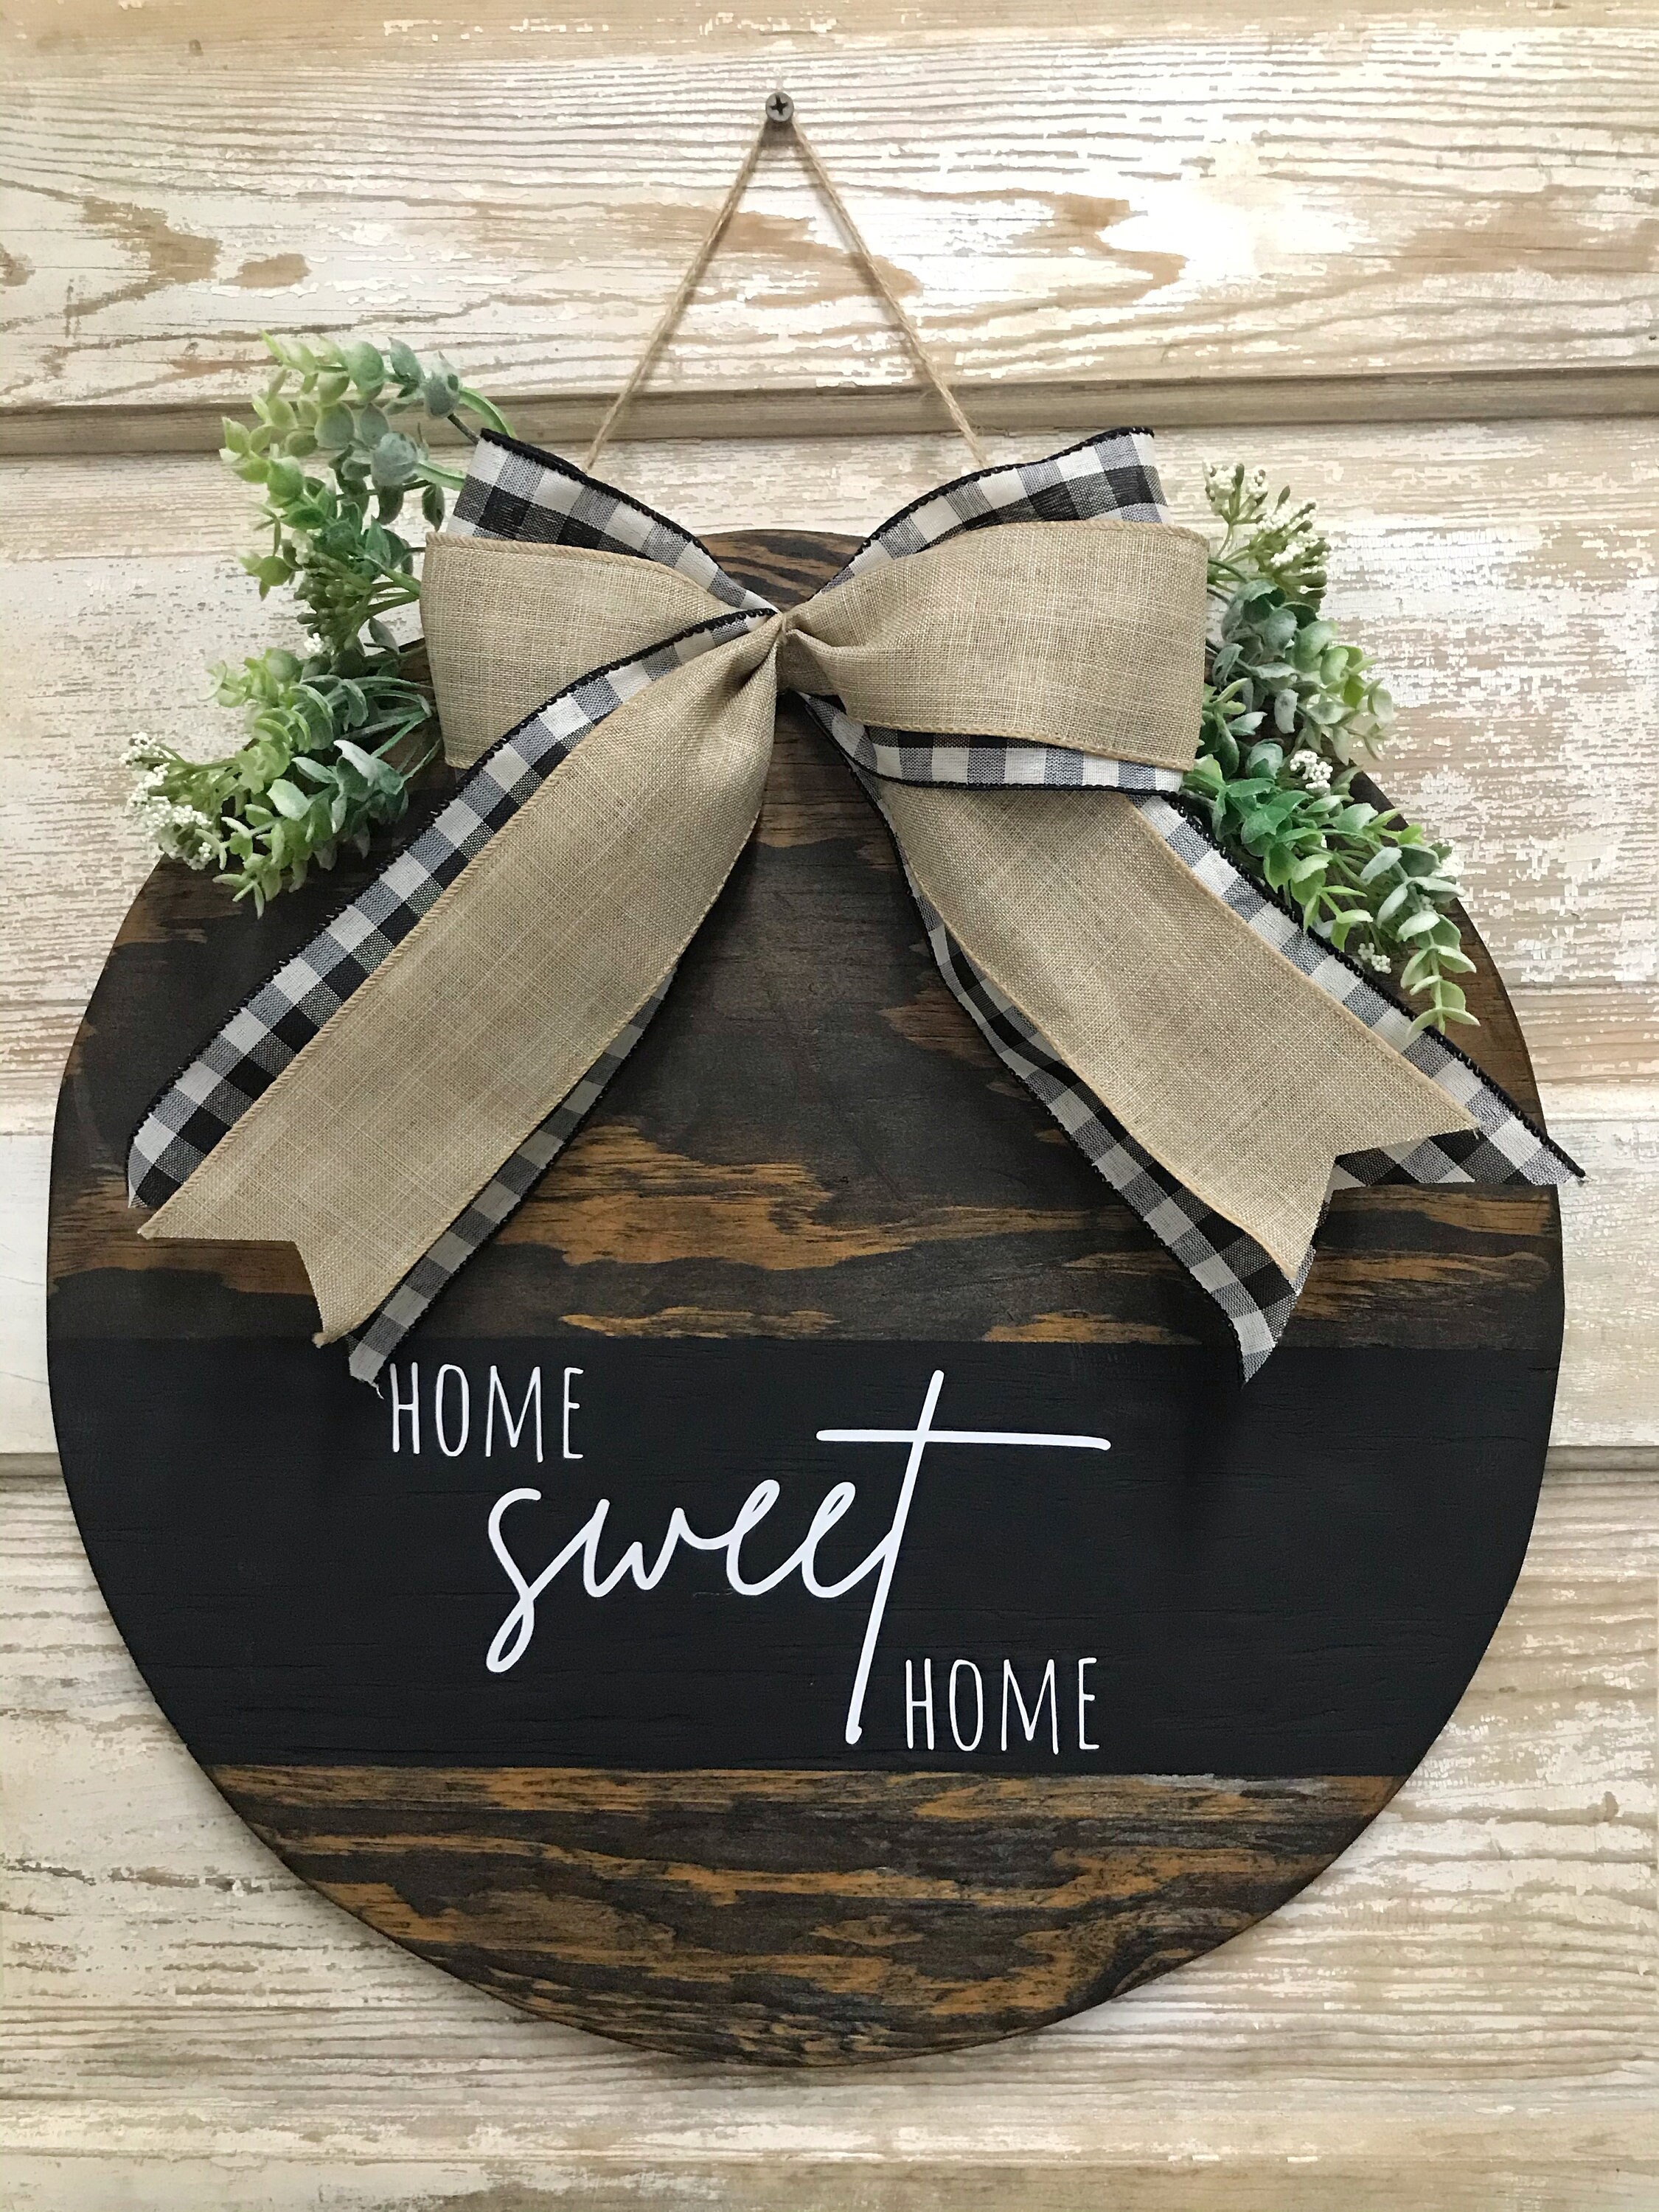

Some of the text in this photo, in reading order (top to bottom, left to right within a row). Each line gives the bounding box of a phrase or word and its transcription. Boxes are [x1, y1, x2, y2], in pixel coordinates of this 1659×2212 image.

[389, 1361, 585, 1464] HOME
[485, 1368, 1112, 1746] sweet
[905, 1656, 1101, 1756] HOME
